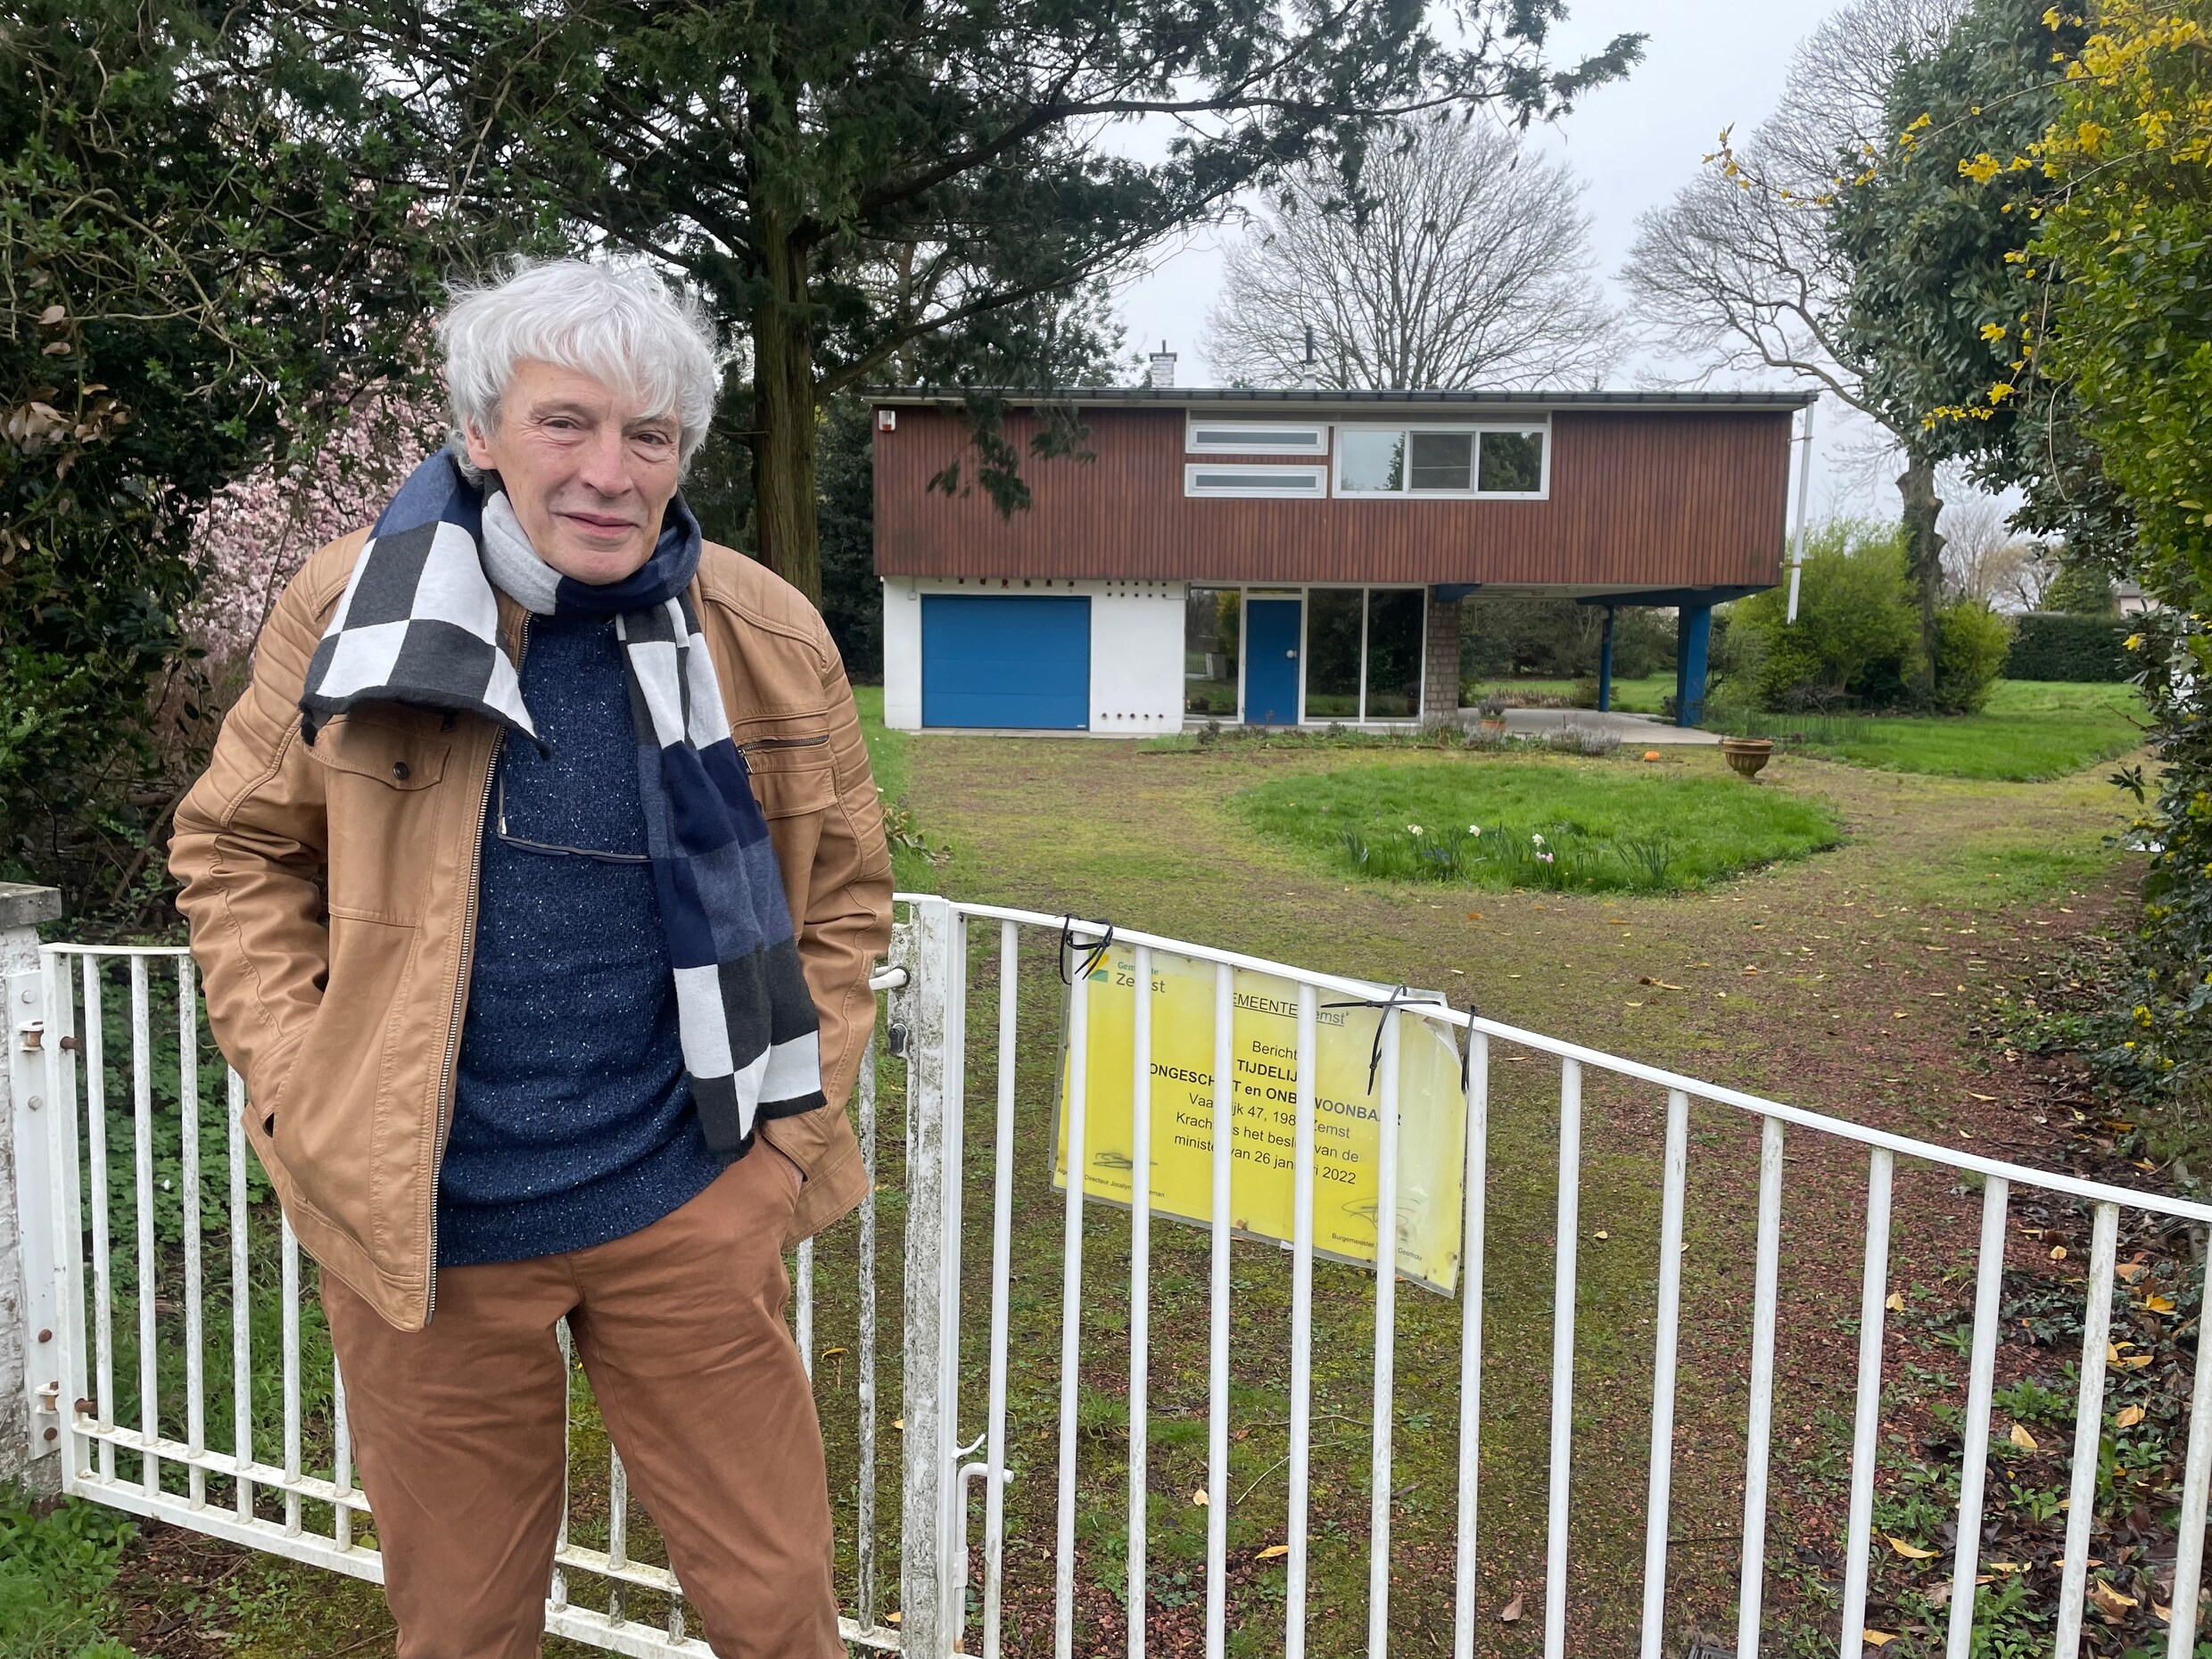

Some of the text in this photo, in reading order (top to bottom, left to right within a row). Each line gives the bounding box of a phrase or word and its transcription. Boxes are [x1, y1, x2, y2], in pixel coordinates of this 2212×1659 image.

[1118, 961, 1160, 976] Gemte
[1116, 972, 1166, 993] Zest
[1233, 992, 1299, 1016] MEENTE
[1252, 1040, 1298, 1061] Bericht
[1237, 1059, 1298, 1083] TIJDELIJ
[1150, 1062, 1401, 1127] ONGESCHT en ONBWOONBA
[1189, 1093, 1244, 1117] Vaaijk
[1247, 1106, 1267, 1122] 47,
[1273, 1110, 1297, 1127] 198
[1176, 1111, 1359, 1163] Krachs het besl van de
[1175, 1135, 1215, 1152] minist
[1254, 1151, 1271, 1165] 26
[1273, 1154, 1319, 1176] jani
[1322, 1166, 1357, 1184] 2022
